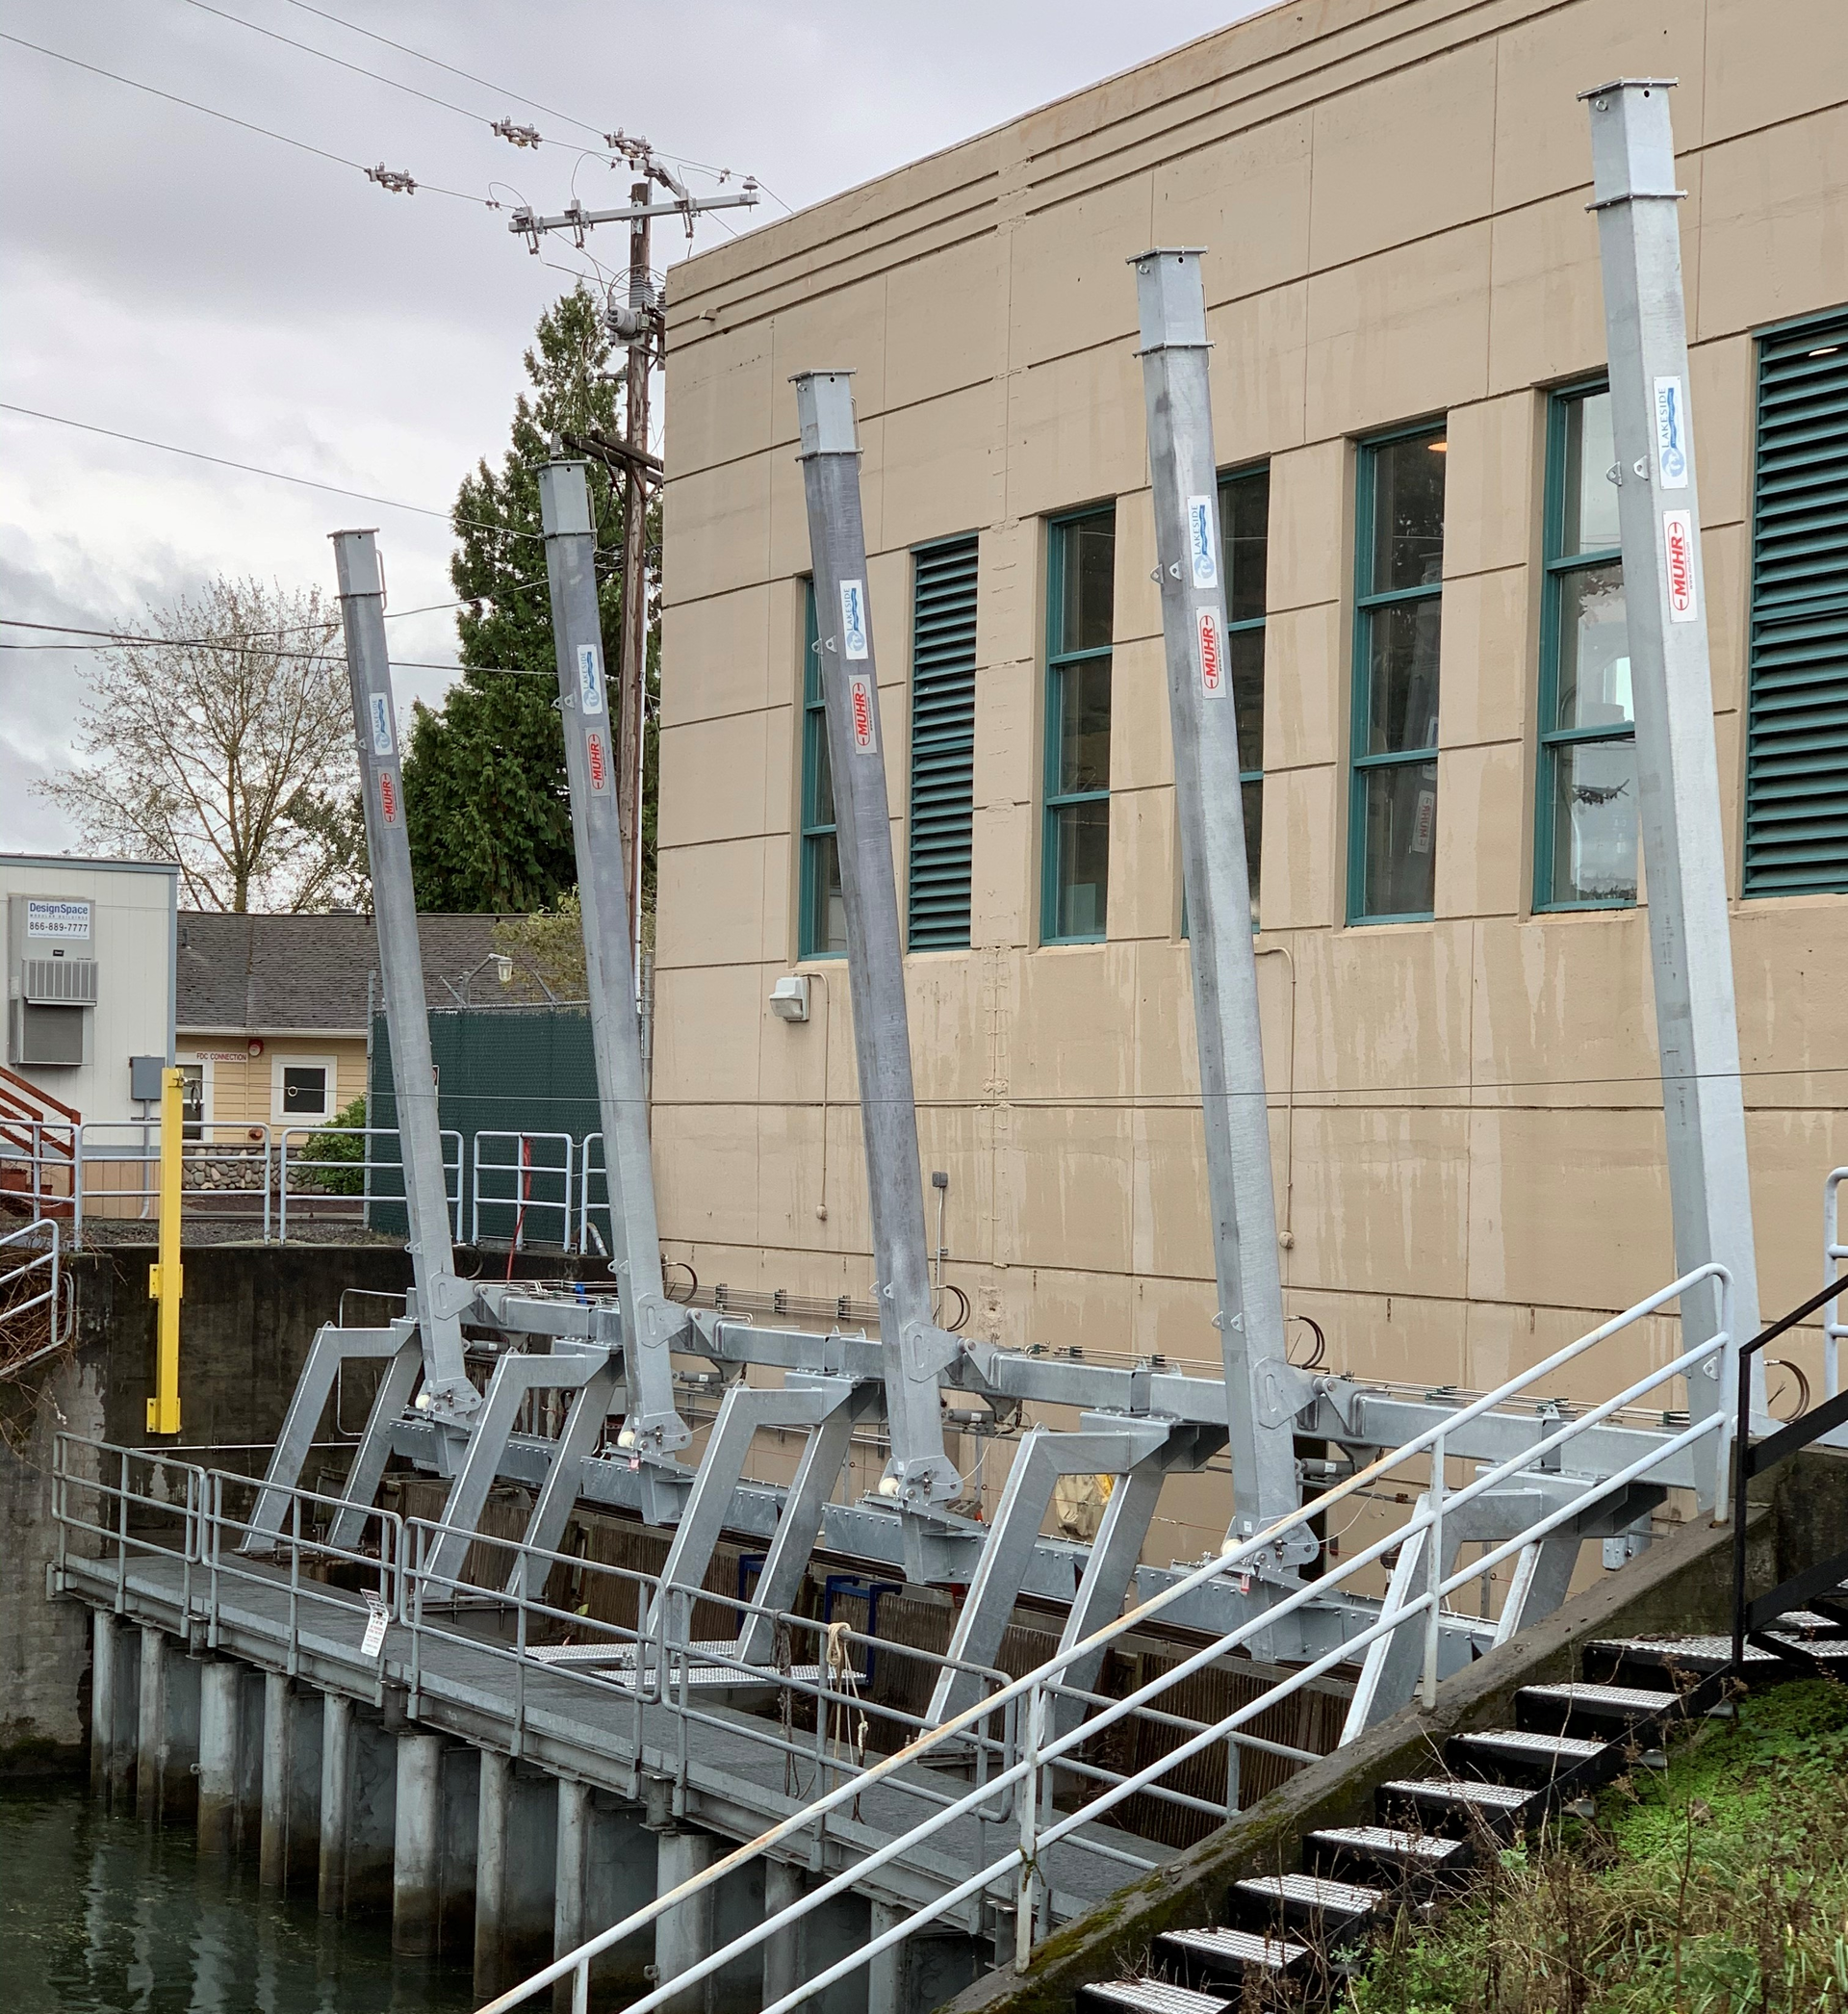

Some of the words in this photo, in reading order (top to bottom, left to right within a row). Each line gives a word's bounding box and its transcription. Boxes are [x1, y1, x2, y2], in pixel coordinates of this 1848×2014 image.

[1658, 387, 1670, 449] LAKESIDE
[1191, 504, 1202, 555] LAKESIDE
[1671, 536, 1687, 597] MUHR
[843, 588, 854, 632] LAKESIDE
[580, 652, 590, 690] LAKESIDE
[1202, 627, 1218, 678] MUHR
[372, 699, 381, 734] LAKESIDE
[855, 692, 869, 736] MUHR
[591, 742, 603, 781] MUHR
[382, 781, 395, 815] MUHR
[29, 902, 89, 916] DesignSpace
[29, 921, 89, 932] 866-889-7777
